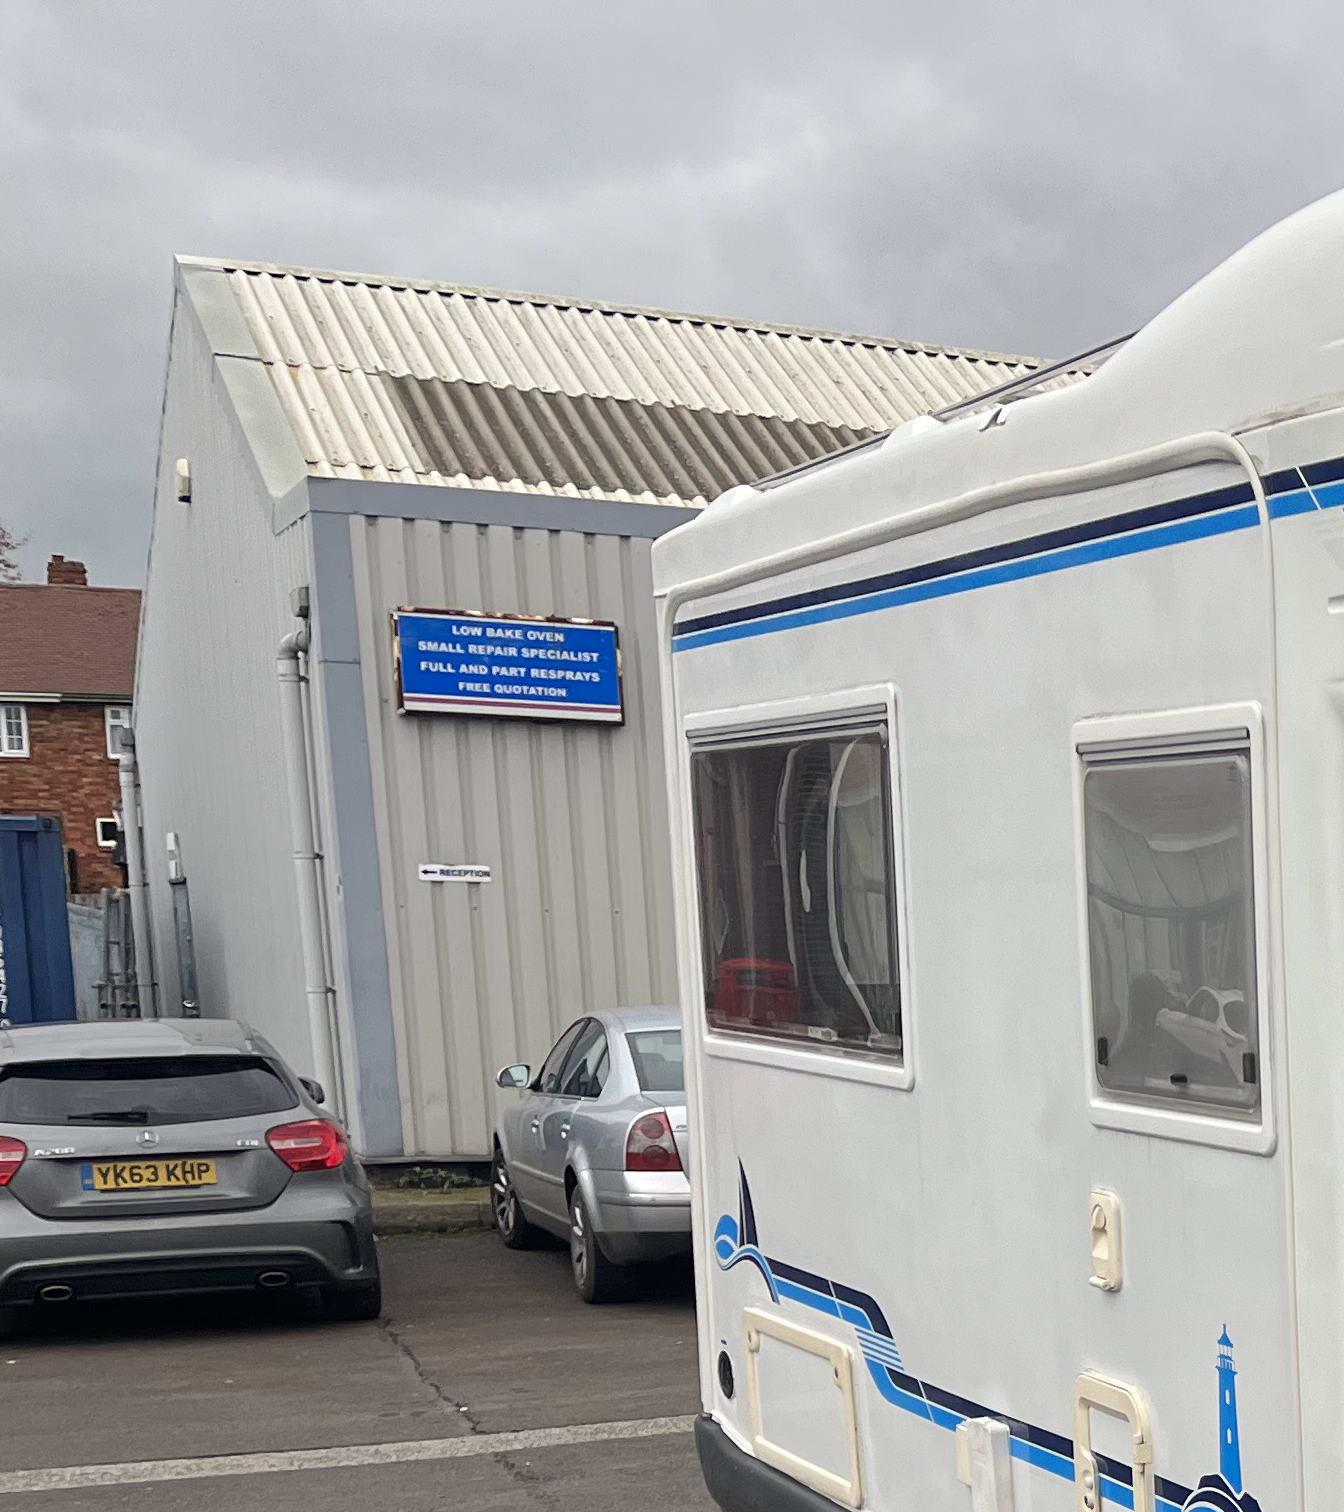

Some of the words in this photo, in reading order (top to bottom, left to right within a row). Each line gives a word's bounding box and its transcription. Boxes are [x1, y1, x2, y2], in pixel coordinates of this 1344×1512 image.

[452, 625, 483, 637] LOW
[486, 627, 524, 640] BAKE
[527, 630, 565, 642] OVEN
[418, 641, 464, 654] SMALL
[468, 645, 518, 657] REPAIR
[521, 647, 599, 663] SPECIALIST
[420, 661, 456, 673] FULL
[459, 664, 488, 675] AND
[492, 666, 526, 678] PART
[530, 669, 600, 682] RESPRAYS
[458, 681, 491, 692] FREE
[494, 684, 567, 697] QUOTATION
[439, 869, 491, 878] RECEPTION
[97, 1164, 159, 1187] YK63
[166, 1160, 210, 1185] KHP
